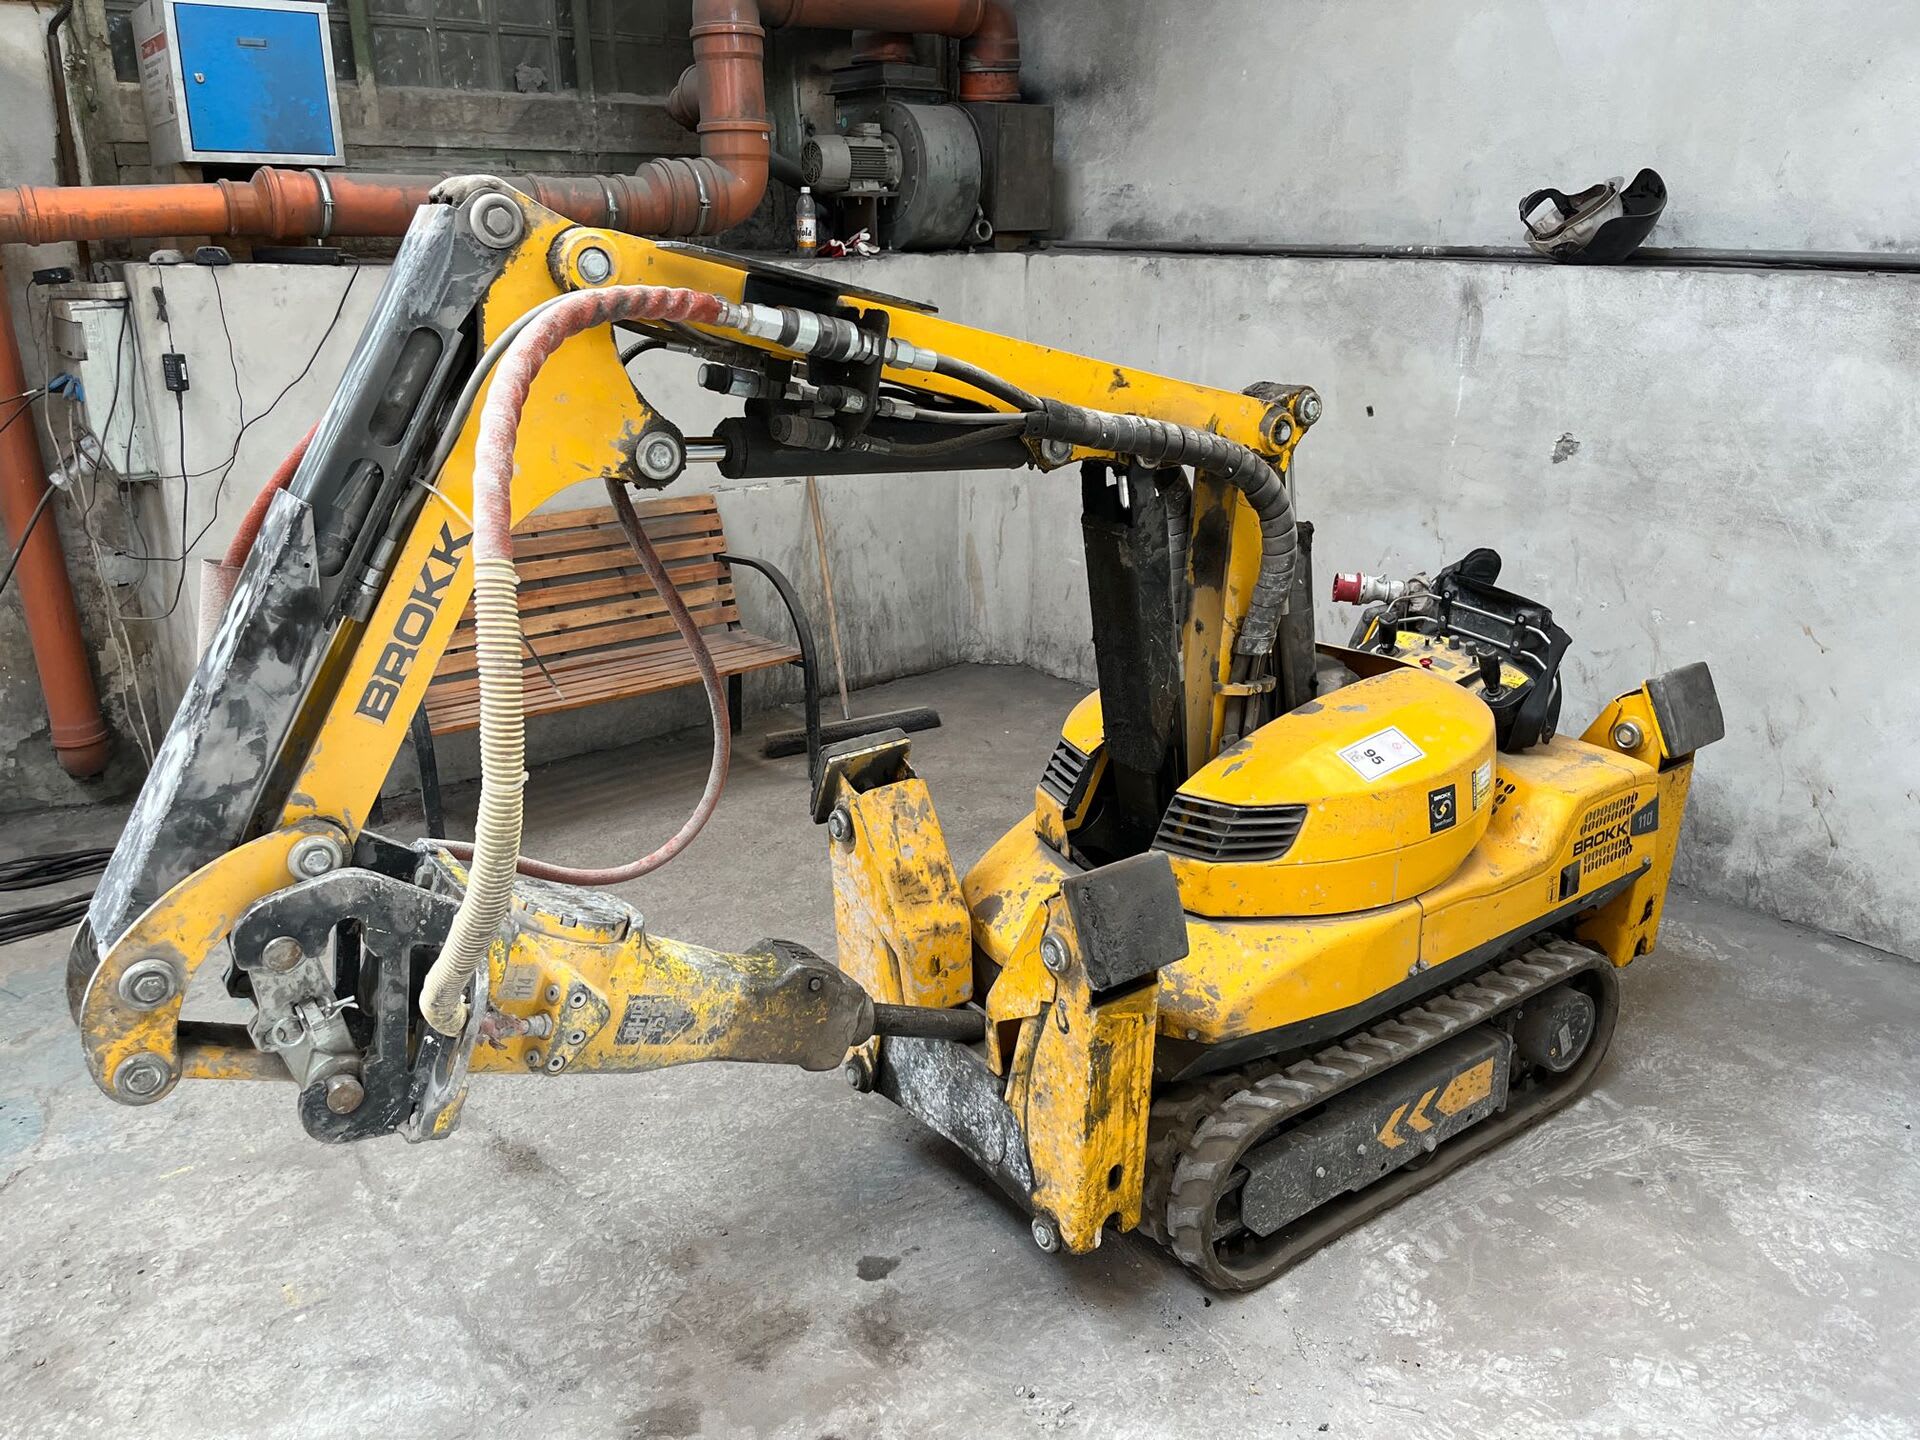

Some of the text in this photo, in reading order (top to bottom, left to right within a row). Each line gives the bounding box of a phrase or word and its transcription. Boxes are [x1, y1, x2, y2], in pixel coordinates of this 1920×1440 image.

[354, 521, 474, 725] BROKK
[1363, 748, 1385, 765] 95
[1638, 810, 1654, 829] 110
[1572, 820, 1629, 857] BROKK
[514, 977, 534, 997] 114
